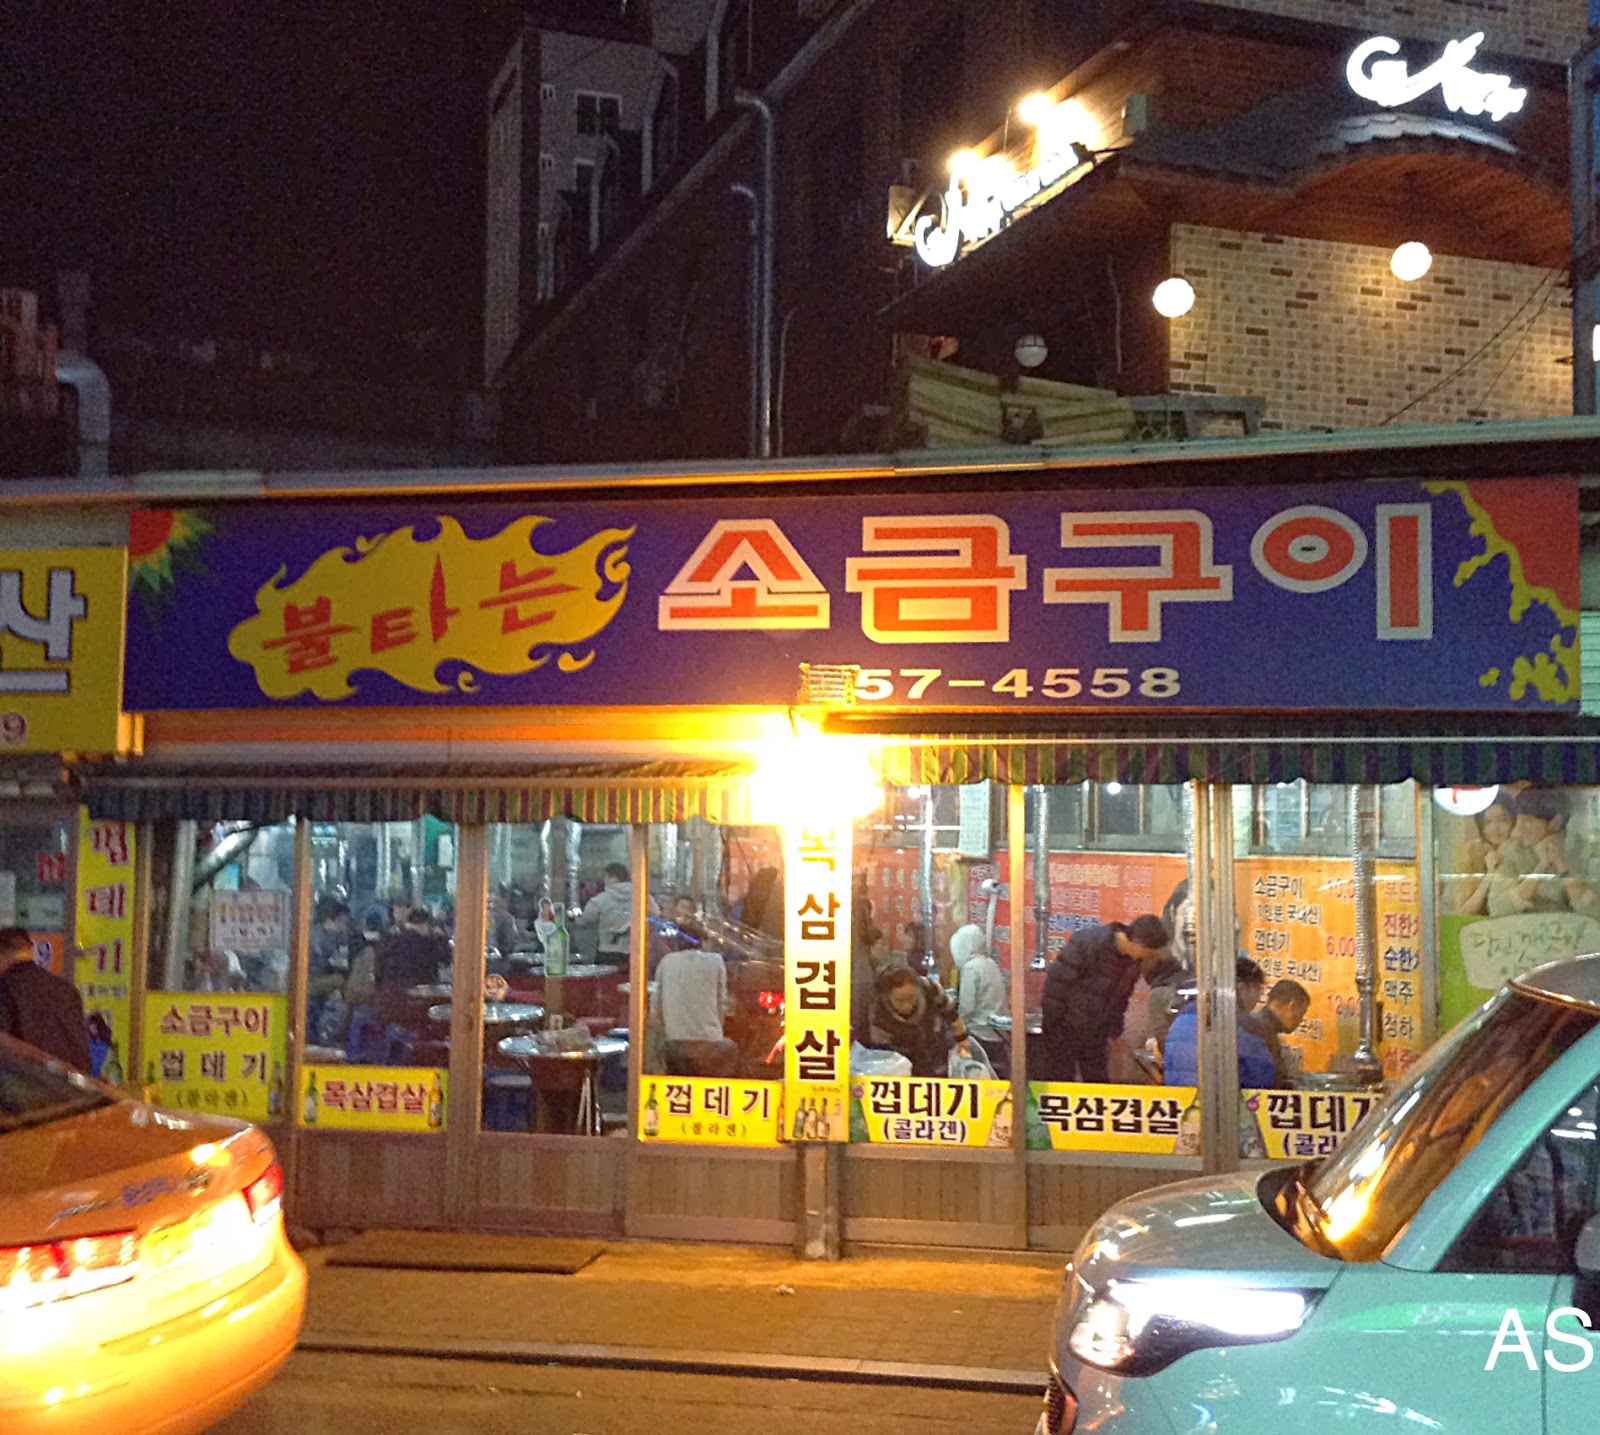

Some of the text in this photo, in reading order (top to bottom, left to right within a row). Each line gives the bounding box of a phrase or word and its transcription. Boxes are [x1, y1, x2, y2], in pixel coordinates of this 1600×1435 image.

[262, 503, 1432, 675] 불타는 소금구이
[855, 667, 1181, 700] 57-4558
[1254, 875, 1356, 902] 소금구이 10,0
[1327, 934, 1357, 959] 6,00
[160, 1004, 269, 1038] 소금구이
[1384, 1012, 1414, 1042] 청하
[322, 1080, 428, 1114] 목삼겹살
[664, 1083, 771, 1120] 껍데기
[870, 1081, 980, 1119] 껍데기
[883, 1117, 967, 1143] (콜라겐)
[1037, 1094, 1182, 1134] 목삼겹살
[1283, 1132, 1338, 1157] (콜라
